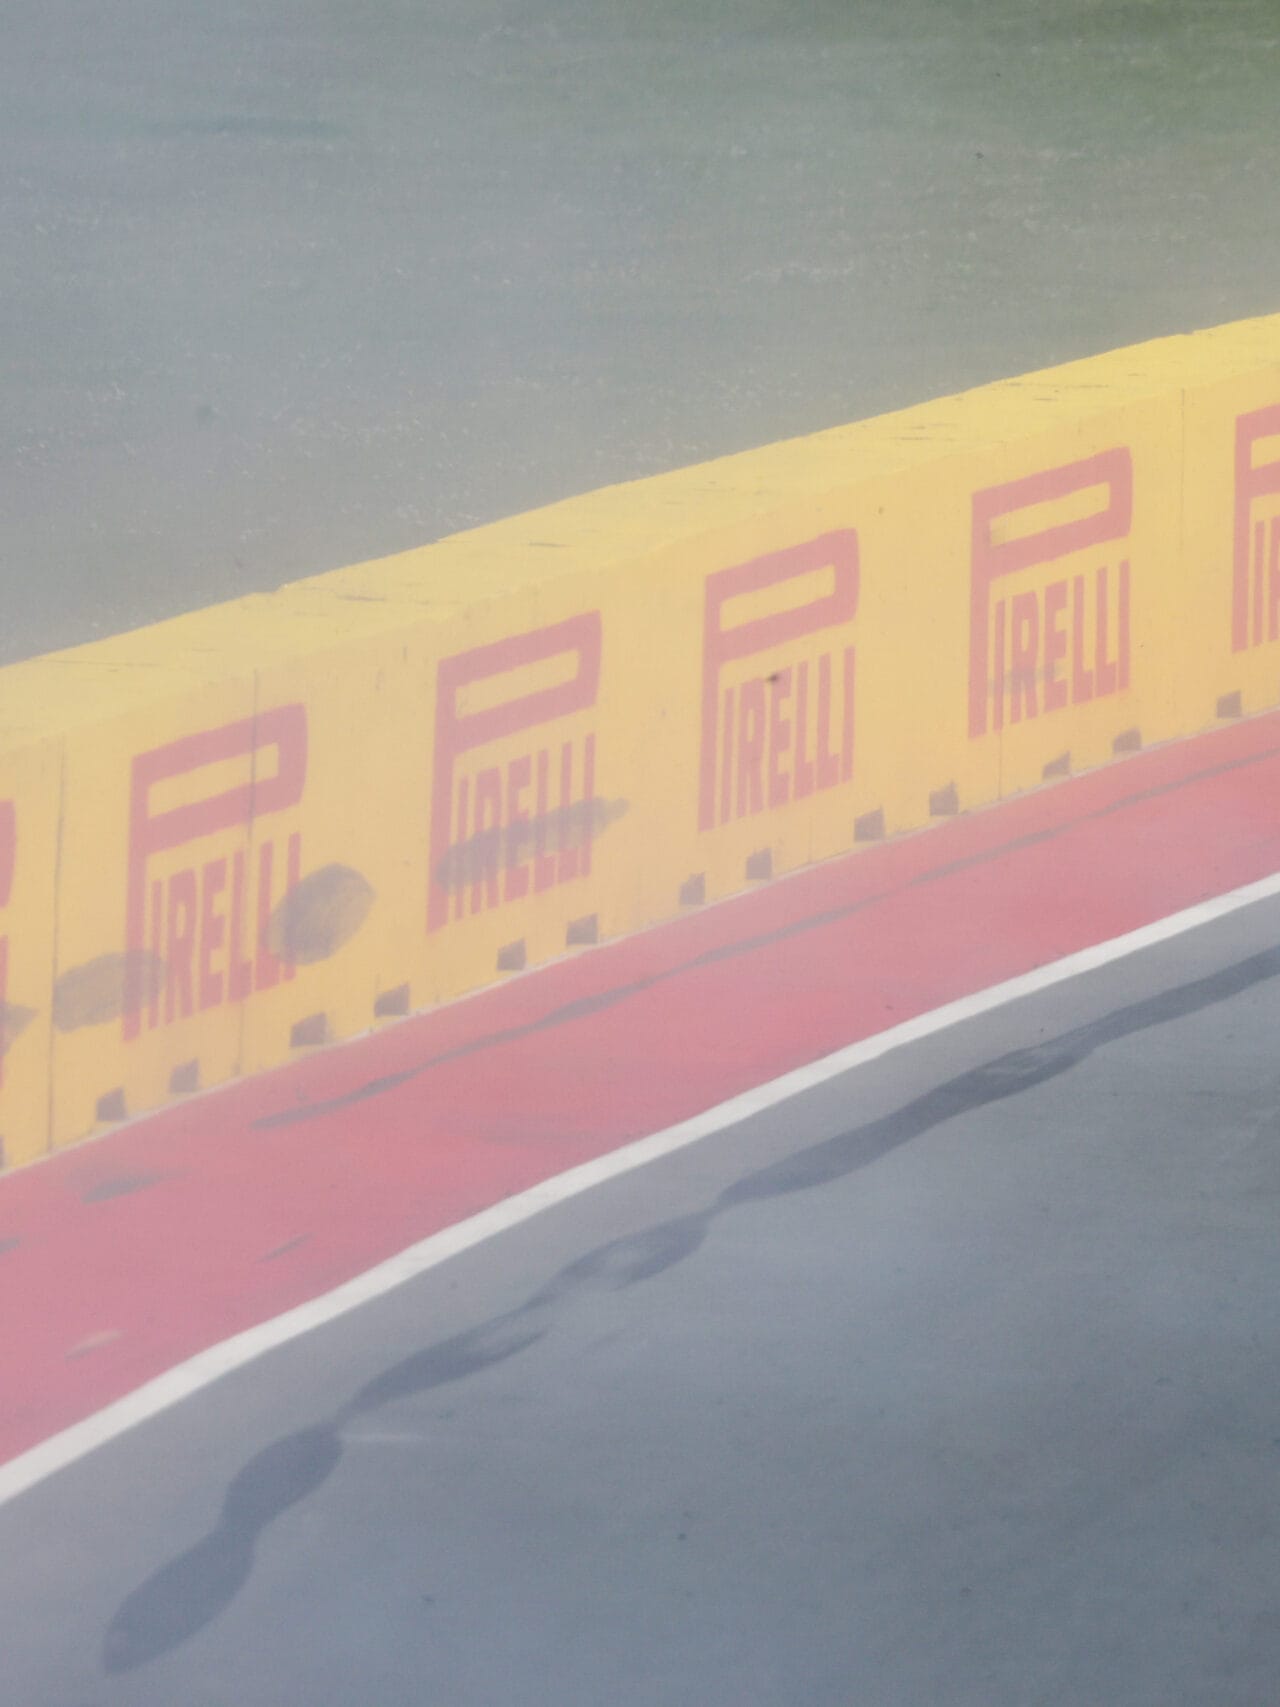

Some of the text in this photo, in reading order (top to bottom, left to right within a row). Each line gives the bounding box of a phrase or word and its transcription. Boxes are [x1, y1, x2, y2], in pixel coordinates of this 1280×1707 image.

[699, 528, 859, 832] PIRELLI
[968, 446, 1133, 740] PIRELLI
[426, 609, 603, 936] PIRELLI
